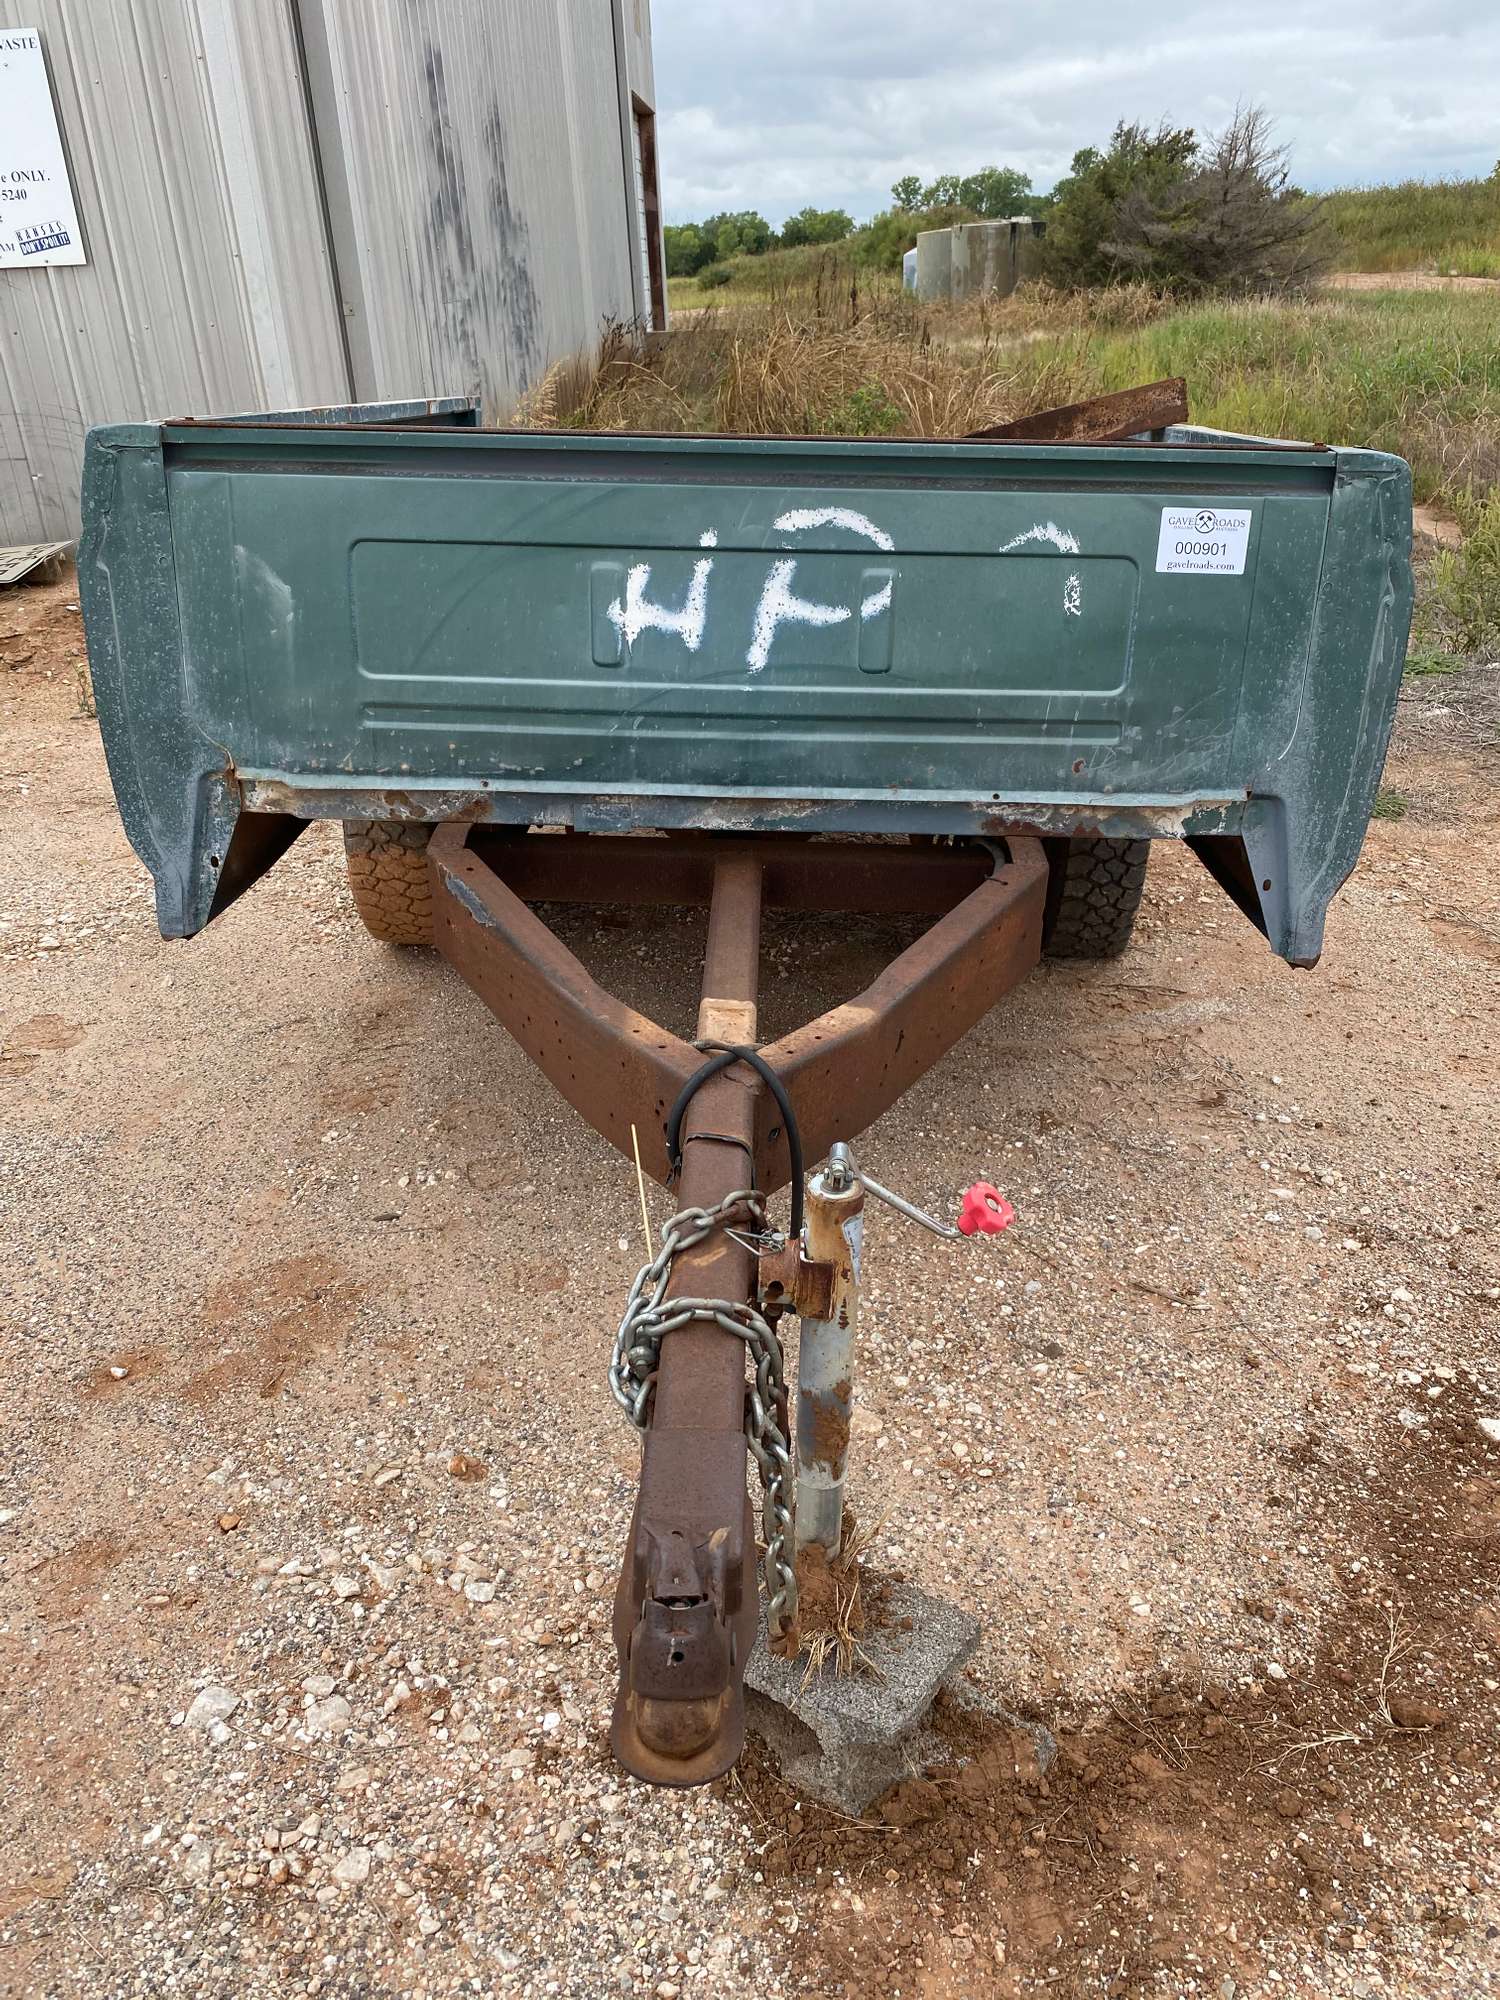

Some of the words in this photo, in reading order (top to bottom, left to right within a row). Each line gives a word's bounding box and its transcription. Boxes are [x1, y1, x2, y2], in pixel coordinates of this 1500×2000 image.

[11, 170, 50, 182] ONLY.
[1, 189, 27, 201] 5240
[16, 221, 62, 241] KANSAS
[1168, 516, 1200, 526] GAVEL
[1212, 518, 1246, 528] ROADS
[1175, 541, 1227, 556] 000901
[1166, 560, 1235, 571] gavelroads.com
